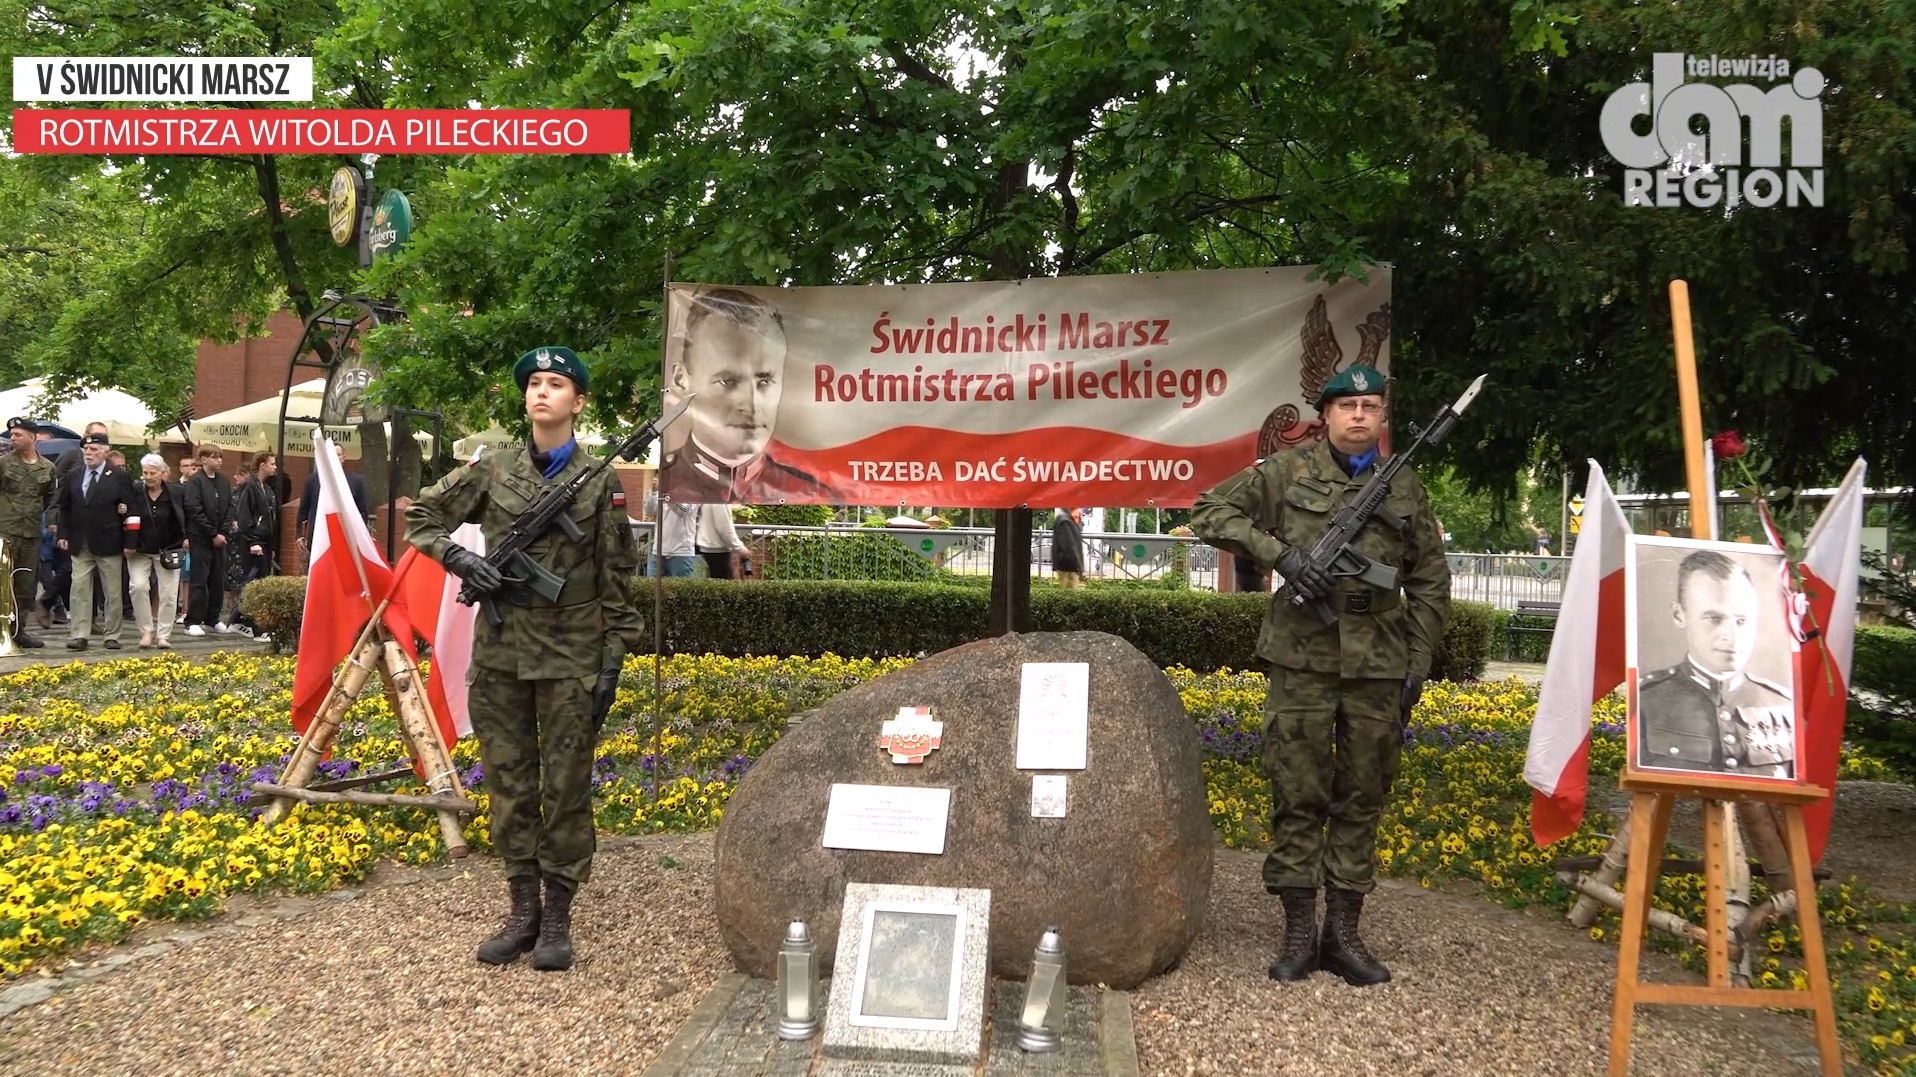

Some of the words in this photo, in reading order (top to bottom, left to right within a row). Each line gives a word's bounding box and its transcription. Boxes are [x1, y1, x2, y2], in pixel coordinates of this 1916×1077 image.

[870, 312, 1047, 354] Świdnicki
[1057, 312, 1171, 351] Marsz
[814, 364, 1015, 402] Rotmistrza
[1028, 359, 1228, 408] Pileckiego
[219, 425, 249, 436] OKOCIM
[309, 428, 351, 442] OOCIM
[848, 460, 943, 483] TRZEBA
[955, 456, 1007, 482] DAĆ
[1013, 456, 1194, 482] ŚWIADECTWO
